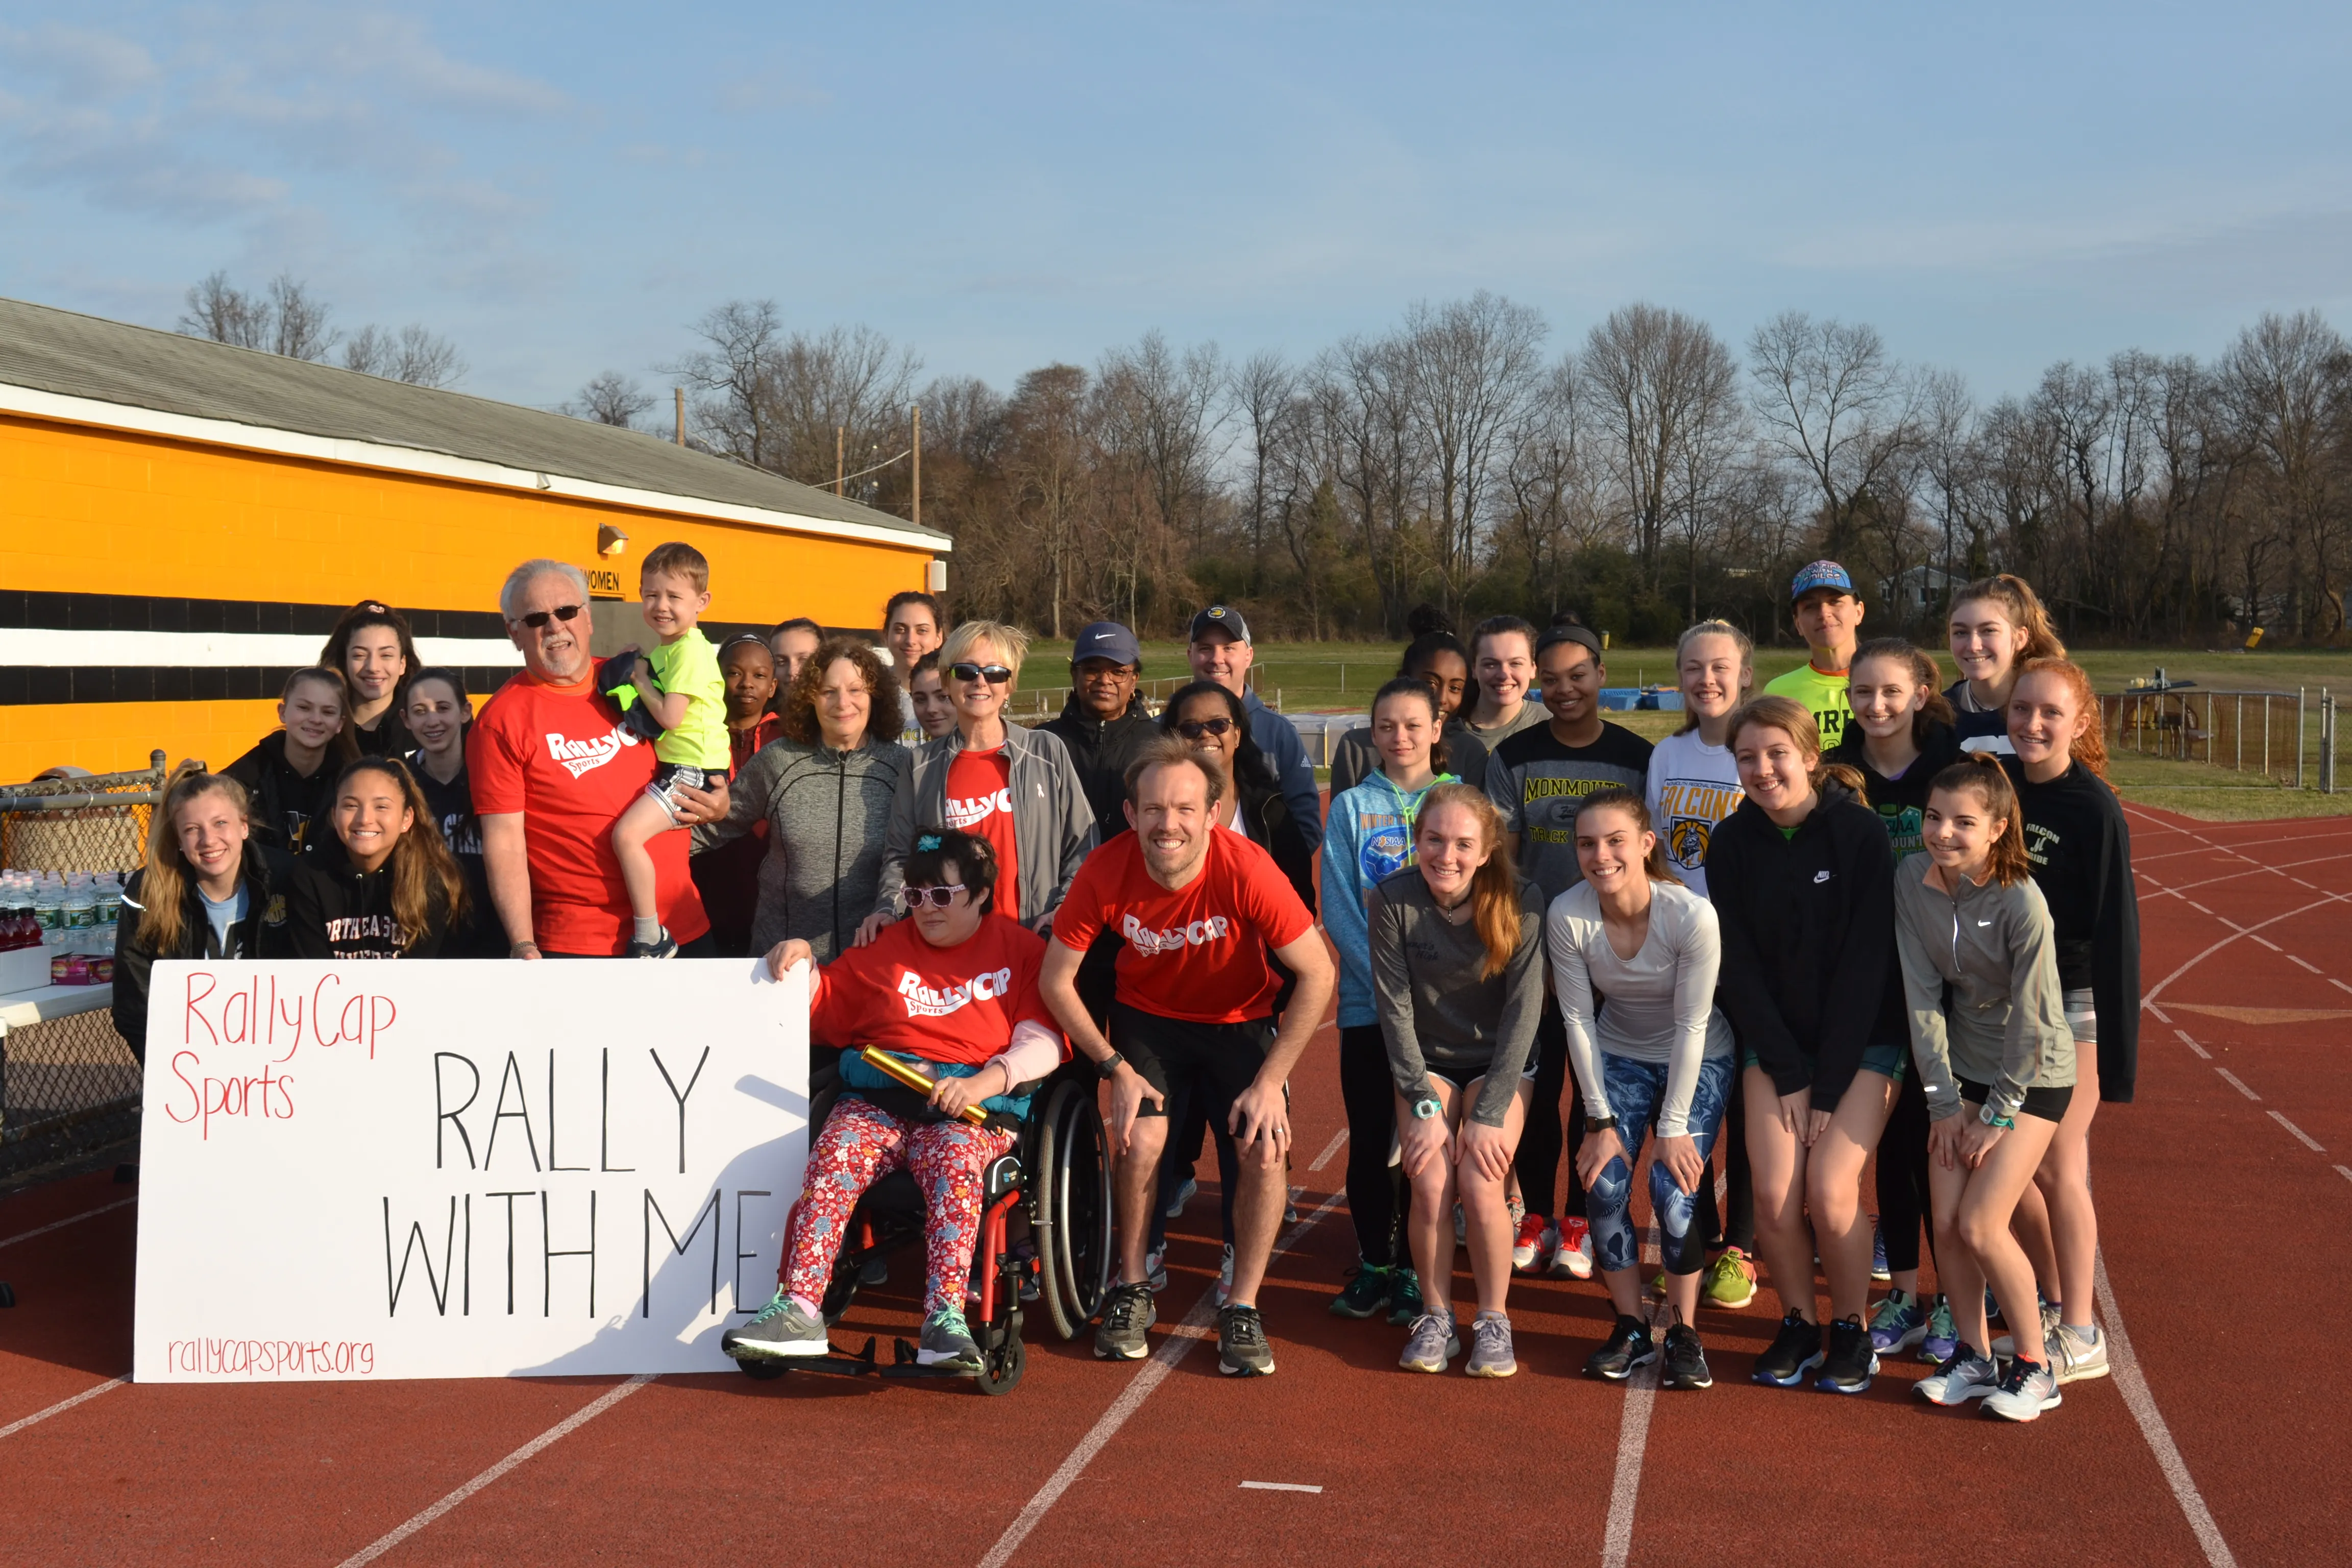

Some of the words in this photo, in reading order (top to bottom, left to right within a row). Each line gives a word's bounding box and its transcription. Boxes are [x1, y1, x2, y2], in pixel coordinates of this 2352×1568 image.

[546, 721, 642, 761] RALLYC
[569, 757, 600, 772] Sports
[945, 788, 1013, 816] ALLYC
[1525, 778, 1626, 804] MONMOU
[946, 817, 967, 827] orts
[1360, 812, 1394, 831] WINTER
[1529, 825, 1569, 843] TRACK
[2026, 823, 2060, 844] FALCON
[2028, 852, 2048, 865] RIDE
[897, 967, 1011, 1001] RALLYCAP
[185, 972, 397, 1062] RallyCap
[910, 1001, 943, 1013] Sports
[165, 1051, 293, 1140] Sports
[434, 1045, 710, 1173] RALLY
[383, 1189, 596, 1318] WITH
[643, 1188, 771, 1318] ME
[169, 1337, 374, 1376] rallycapsports.org
